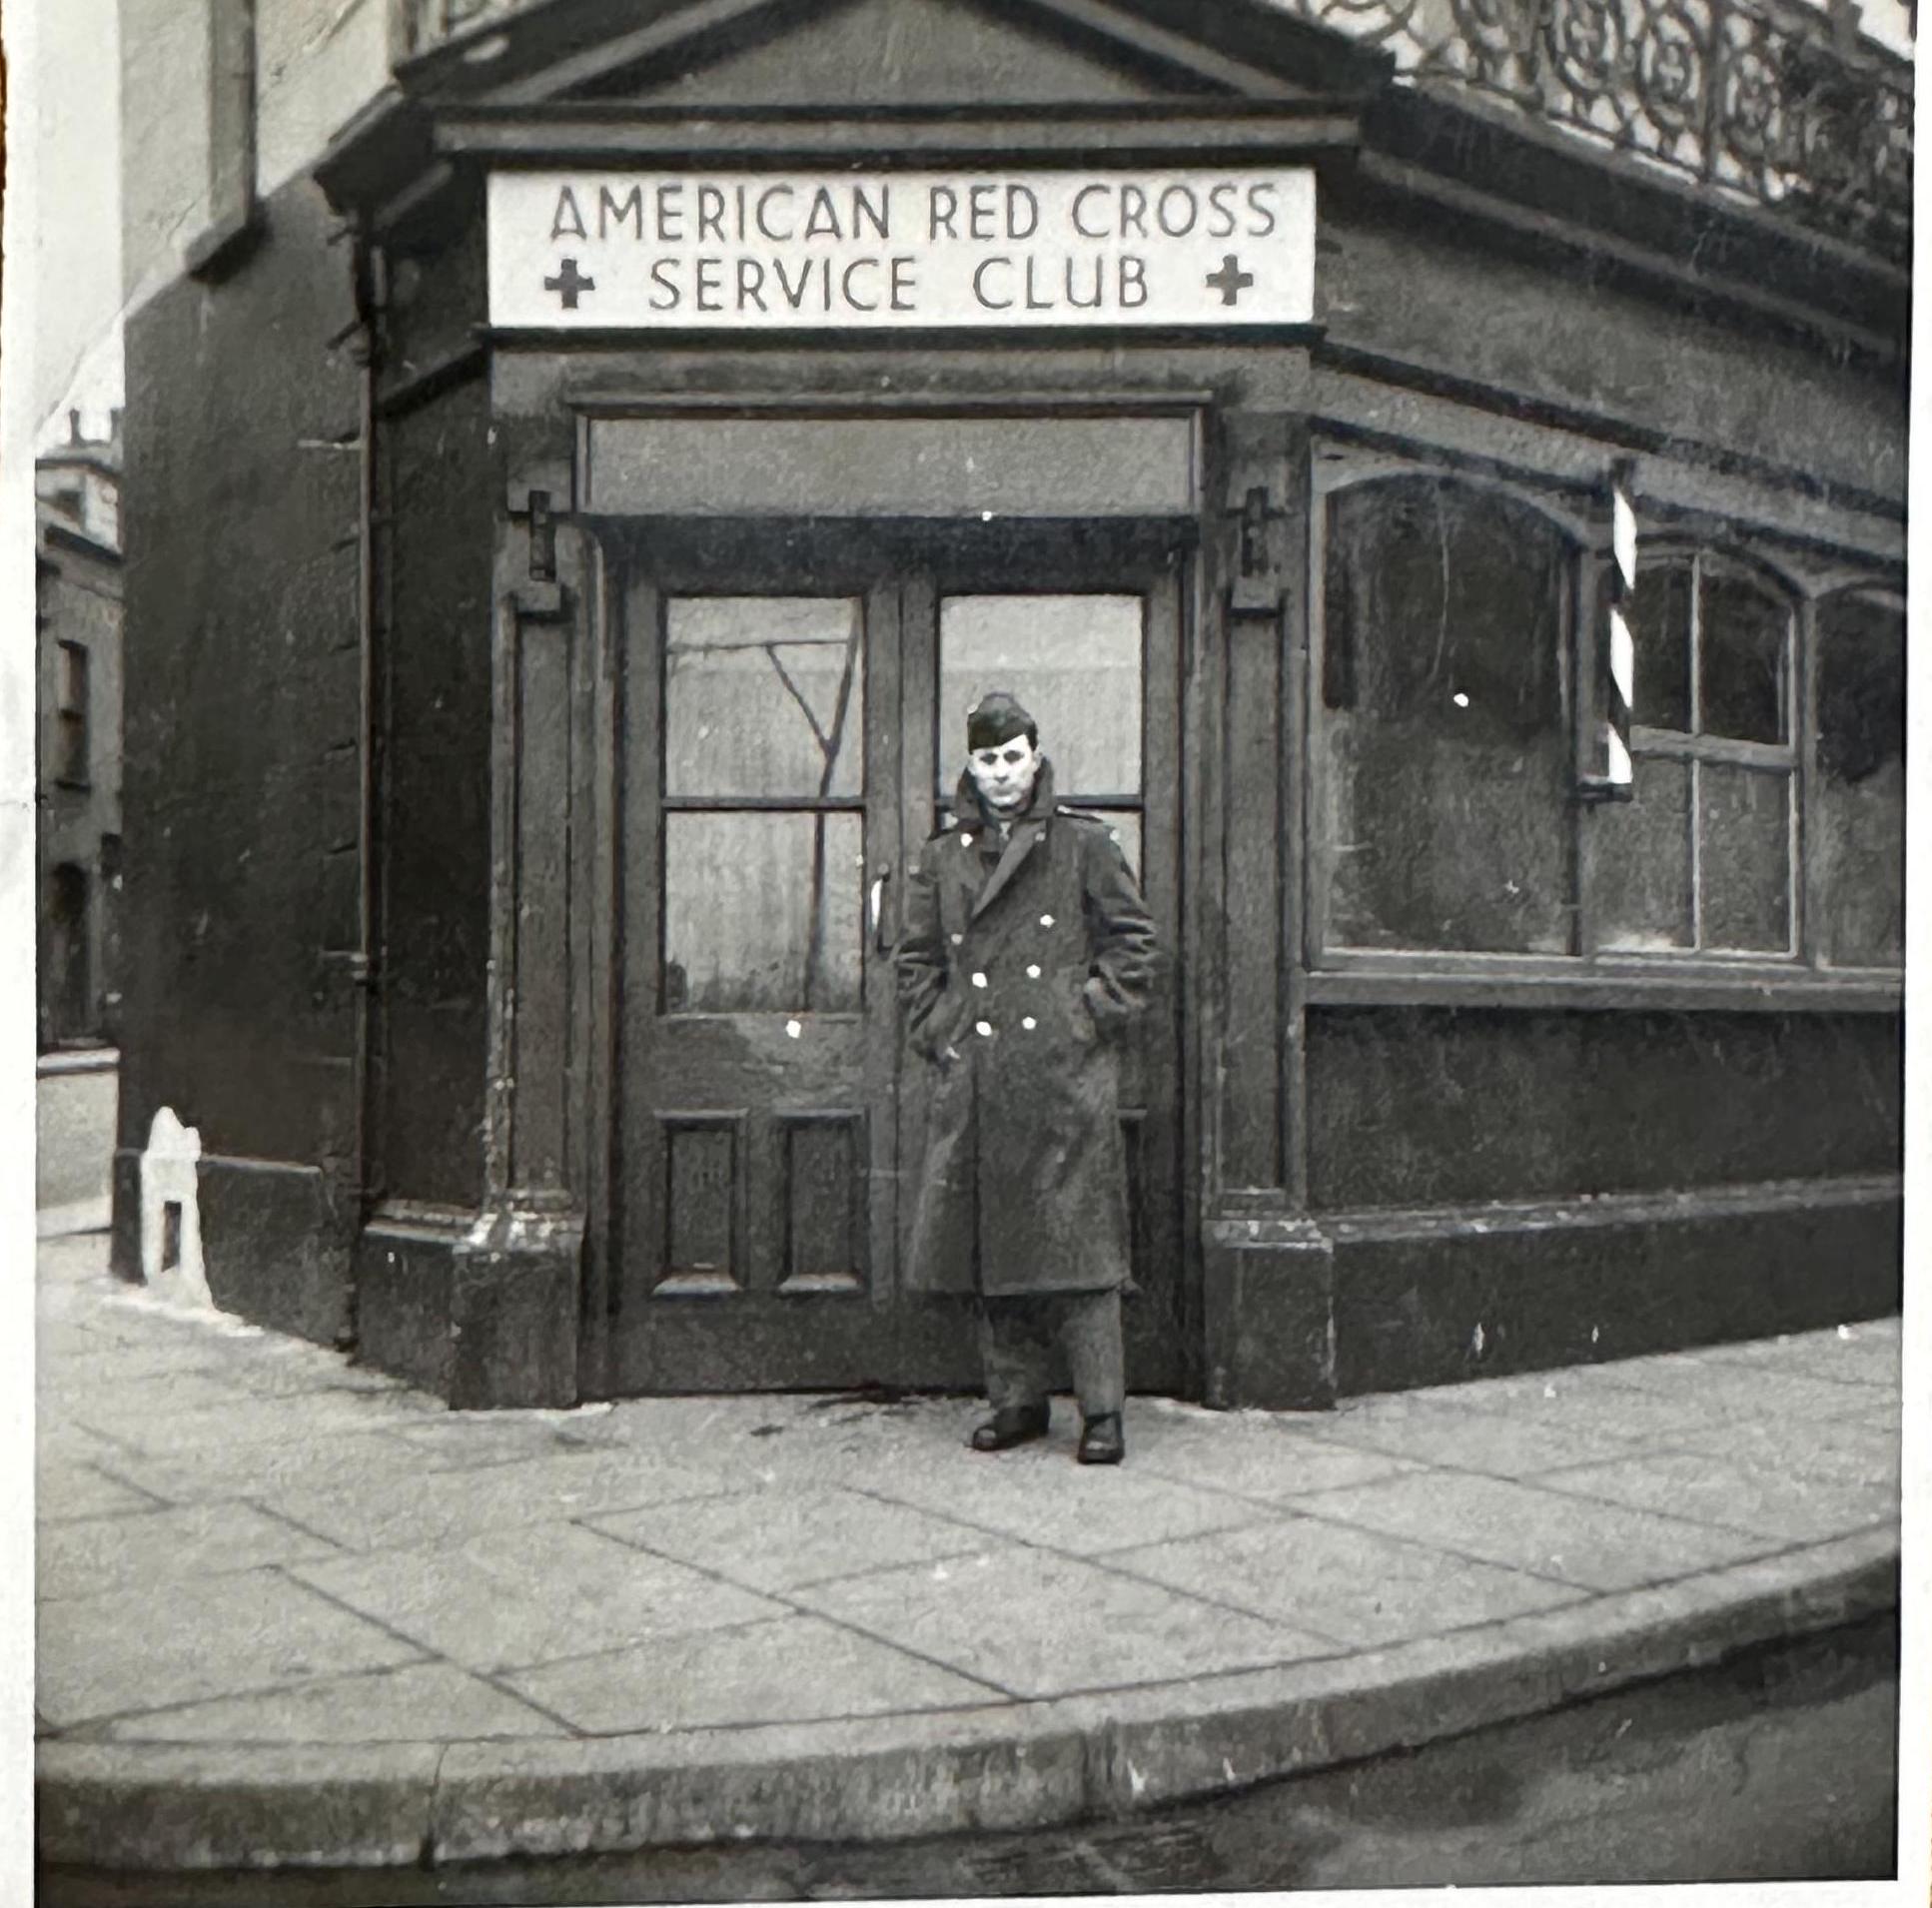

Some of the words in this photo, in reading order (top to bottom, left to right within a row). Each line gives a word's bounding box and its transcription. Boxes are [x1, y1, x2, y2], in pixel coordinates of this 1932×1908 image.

[550, 185, 890, 241] AMERICAN
[929, 184, 1040, 240] RED
[1071, 184, 1277, 239] CROSS
[649, 257, 917, 312] SERVICE
[973, 257, 1149, 310] CLUB
